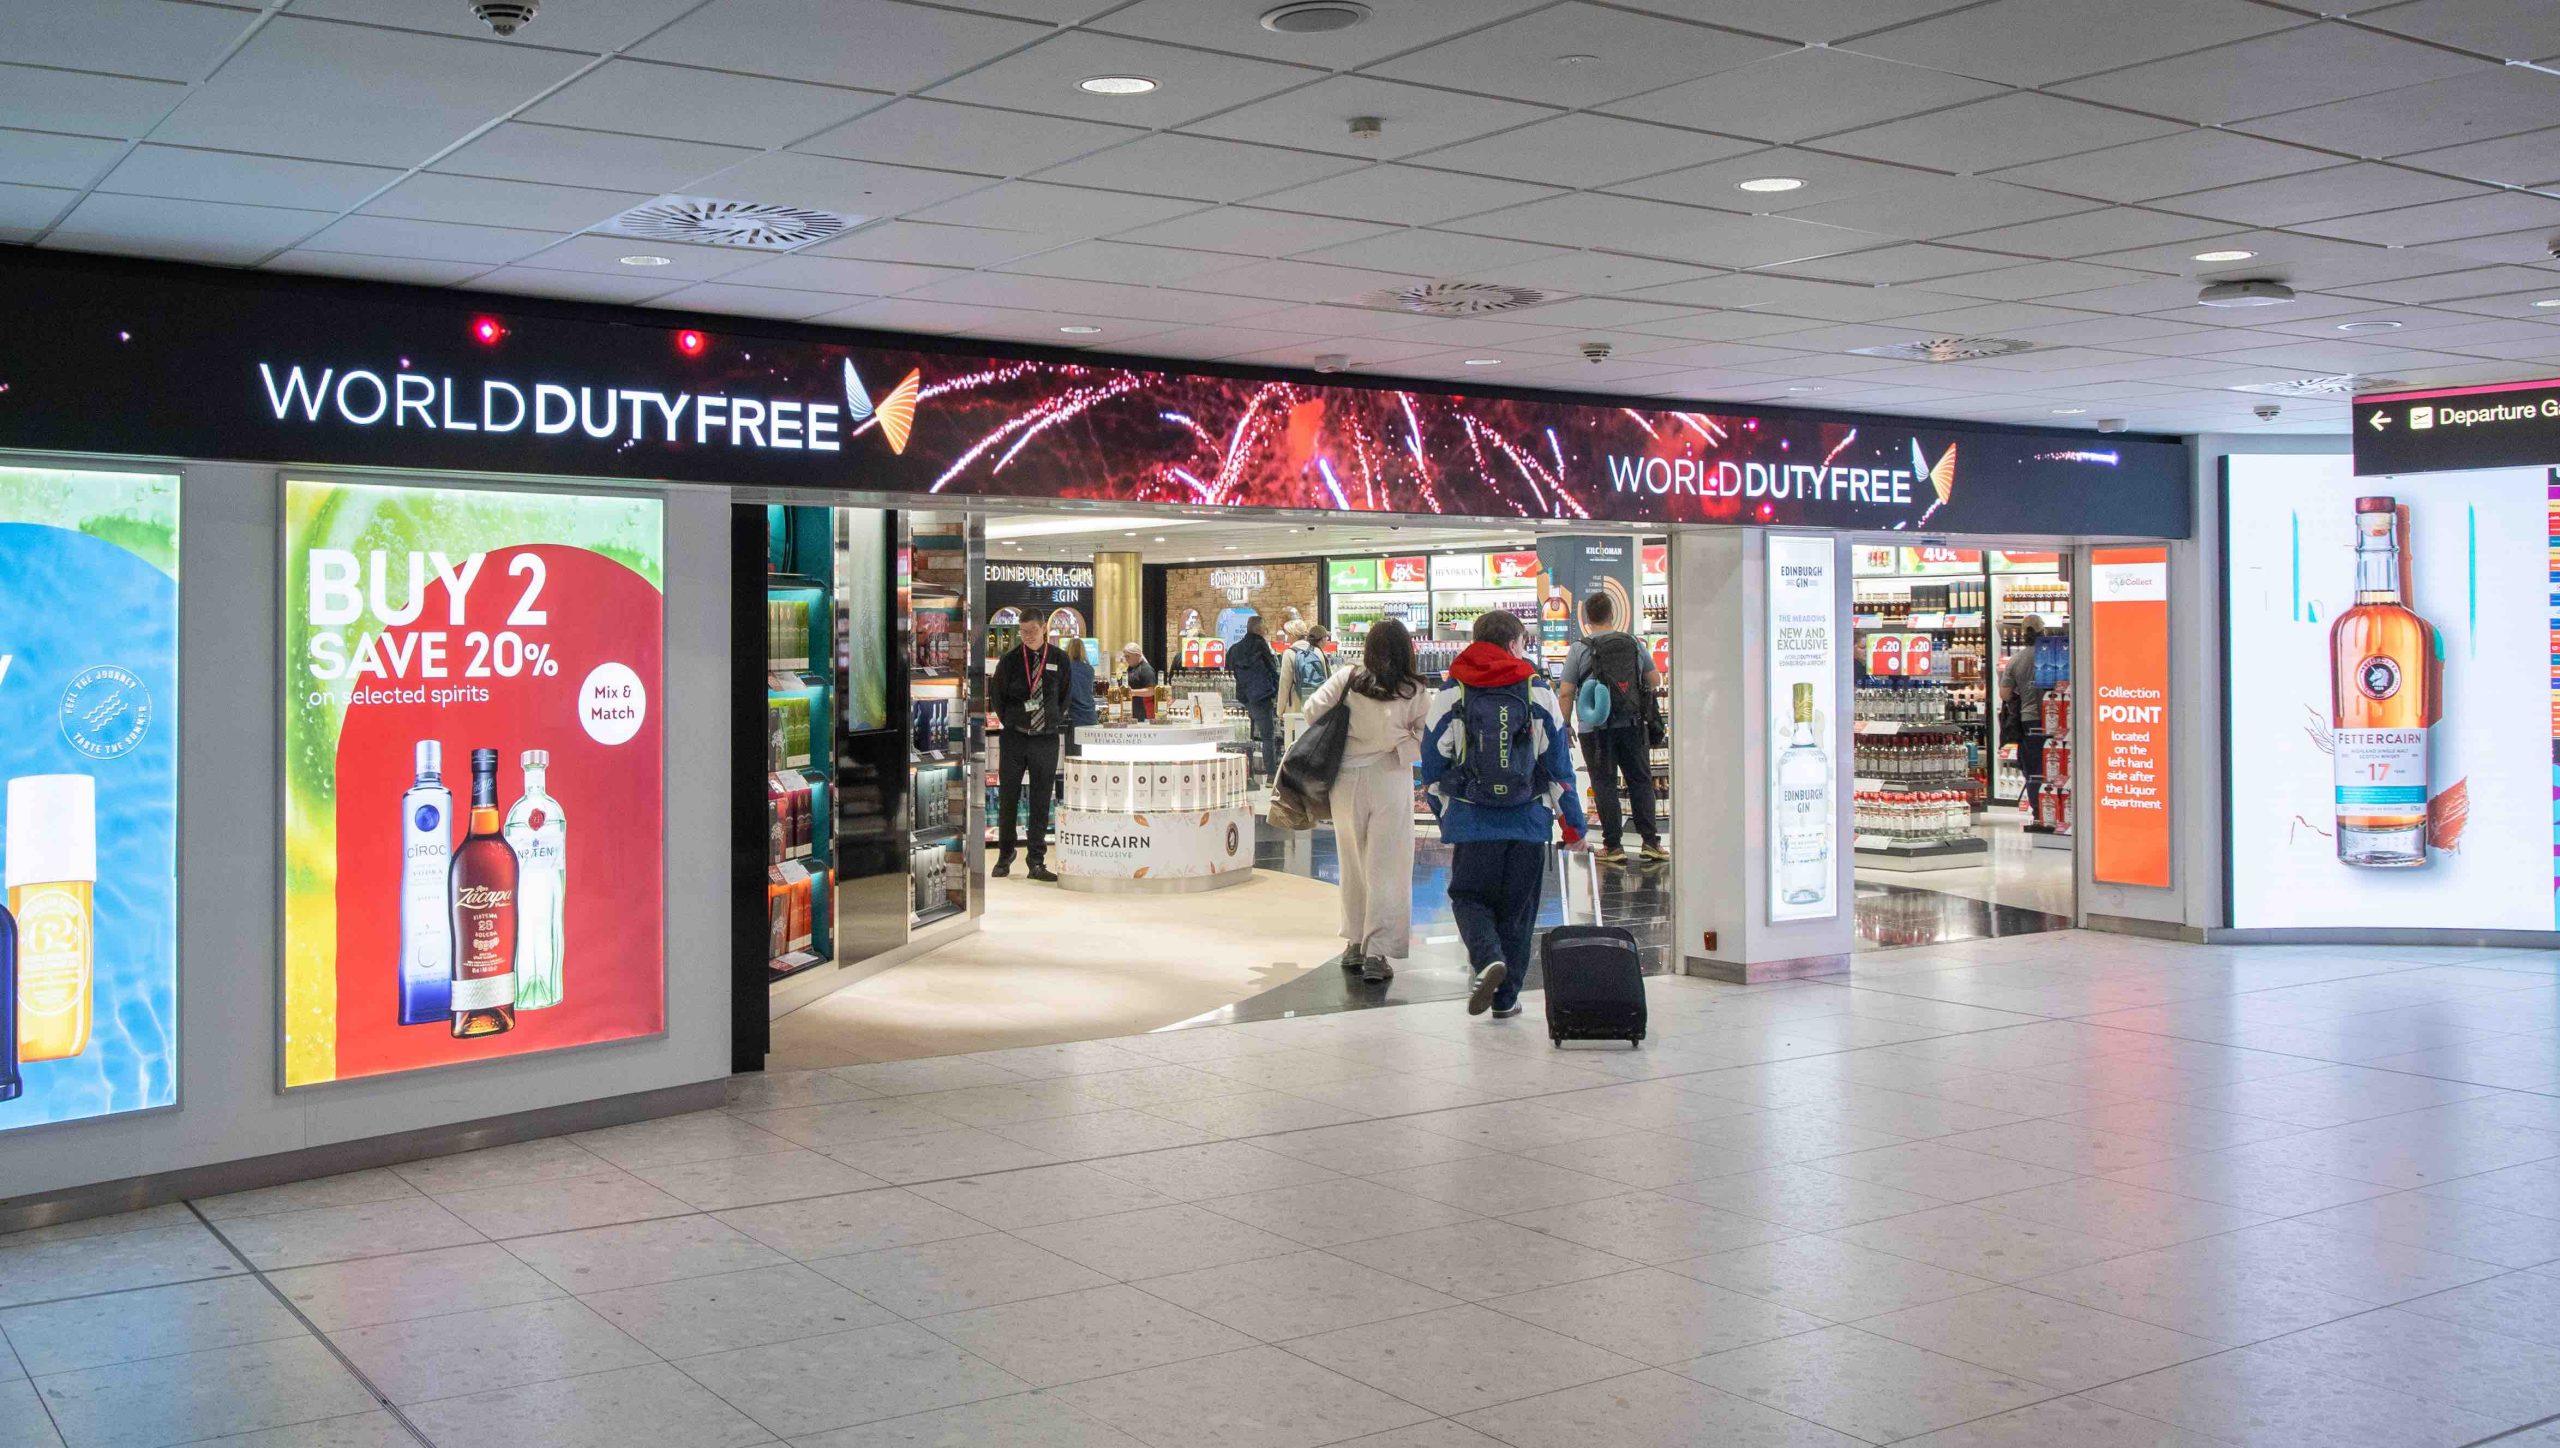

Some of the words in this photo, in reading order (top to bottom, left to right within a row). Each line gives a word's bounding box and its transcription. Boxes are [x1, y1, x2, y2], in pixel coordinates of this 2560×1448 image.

[2440, 404, 2536, 427] Departure
[1781, 565, 1823, 577] EDINBURGH
[309, 548, 487, 627] BUY
[506, 552, 547, 626] 2
[1796, 578, 1808, 588] GIN
[1059, 589, 1079, 602] GIN
[1779, 627, 1802, 639] NEW
[1805, 627, 1825, 639] AND
[1777, 639, 1828, 650] EXCLUSIVE
[310, 631, 448, 680] SAVE
[464, 631, 559, 678] 20%
[310, 690, 334, 706] on
[343, 685, 425, 705] selected
[430, 685, 490, 709] spirits
[595, 685, 618, 699] Mix
[623, 685, 631, 698] &
[2098, 686, 2160, 699] Collection
[592, 705, 635, 720] Match
[2099, 705, 2162, 723] POINT
[1499, 706, 1508, 768] ORTOVOX
[2111, 730, 2150, 742] located
[2339, 733, 2421, 744] FETTERCAIRN
[2114, 746, 2128, 754] on
[2130, 744, 2147, 755] the
[2108, 756, 2125, 768] left
[2128, 758, 2153, 769] hand
[2107, 770, 2128, 781] side
[2129, 771, 2155, 782] after
[2368, 763, 2391, 781] 17
[1784, 789, 1823, 802] EDINBURGH
[2106, 783, 2123, 794] the
[2125, 784, 2157, 797] Liquor
[1797, 802, 1810, 814] GIN
[2101, 796, 2162, 809] department
[1060, 830, 1151, 849] FETTERCAIRN
[1090, 850, 1134, 859] EXCLUSIVE
